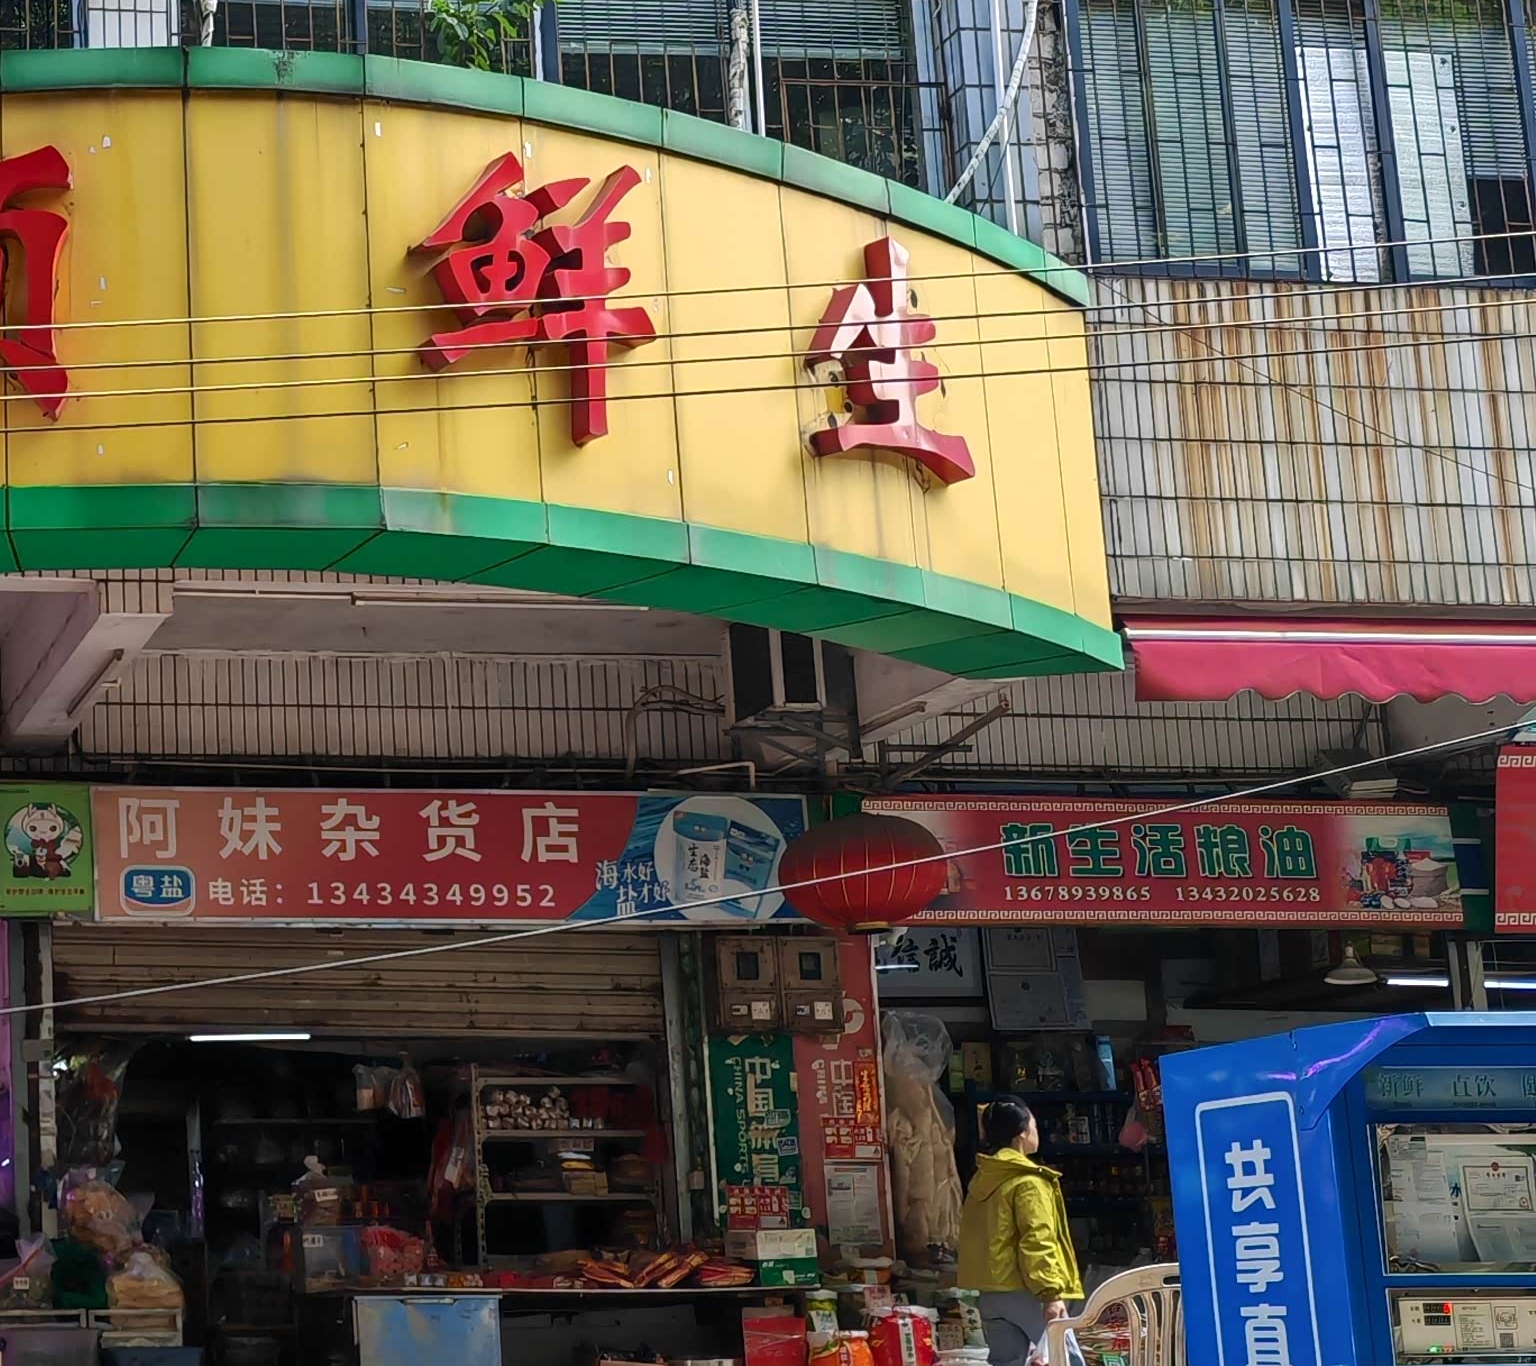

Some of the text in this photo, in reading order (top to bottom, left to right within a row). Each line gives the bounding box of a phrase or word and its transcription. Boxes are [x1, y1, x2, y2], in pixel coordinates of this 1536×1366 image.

[117, 796, 580, 864] 阿妹杂货店
[999, 821, 1317, 881] 新生活粮油
[130, 874, 184, 900] 粤盐
[307, 881, 556, 908] 13434349952
[1003, 885, 1321, 904] 13678939865 13432025628
[878, 933, 964, 977] 誠信
